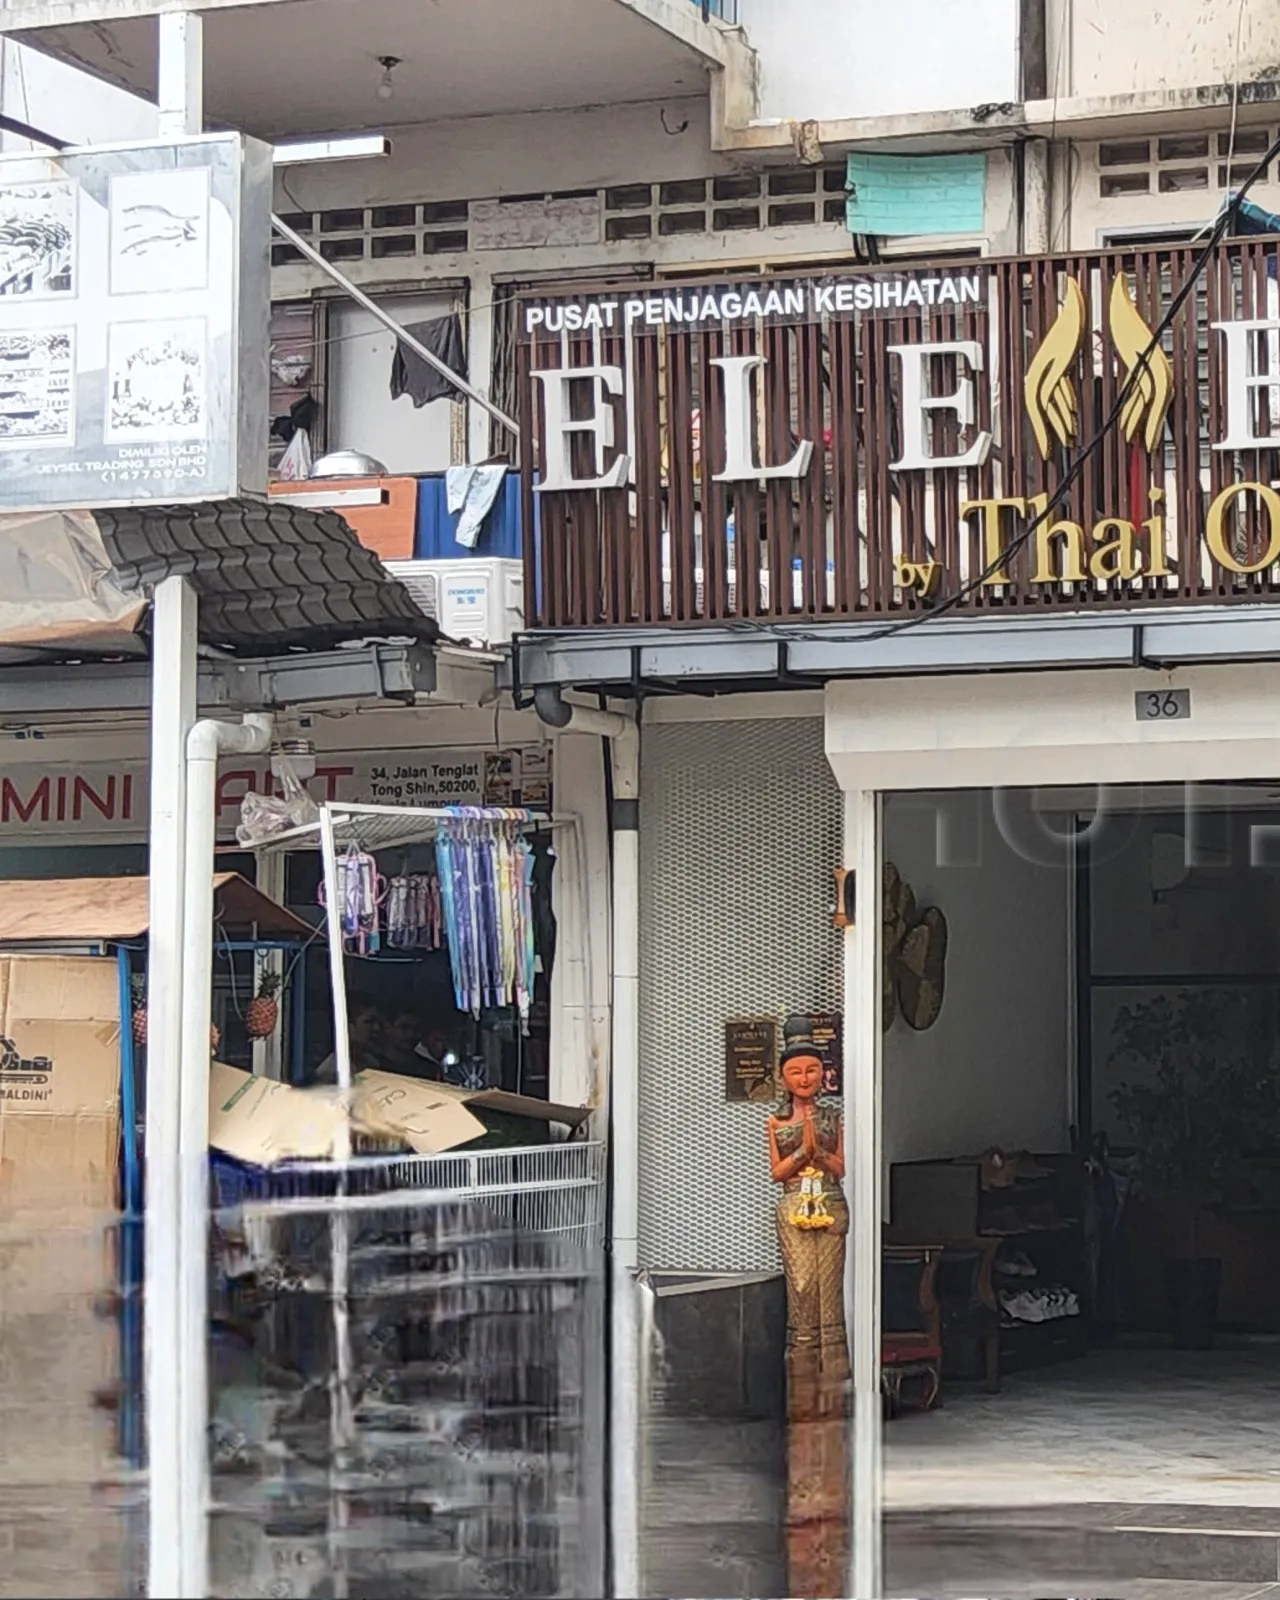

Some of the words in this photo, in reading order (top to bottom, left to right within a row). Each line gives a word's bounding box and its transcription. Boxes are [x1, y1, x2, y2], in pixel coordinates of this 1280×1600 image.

[526, 303, 614, 334] PUSAT
[627, 286, 803, 326] PENJAGAAN
[814, 276, 981, 313] KESIHATAN
[85, 458, 145, 471] TRADING
[894, 554, 941, 598] by
[960, 487, 1173, 587] Thai
[1146, 692, 1179, 718] 36
[371, 768, 390, 781] 34,
[393, 765, 428, 779] Jalan
[1, 773, 133, 823] MINI
[371, 783, 403, 797] Tong
